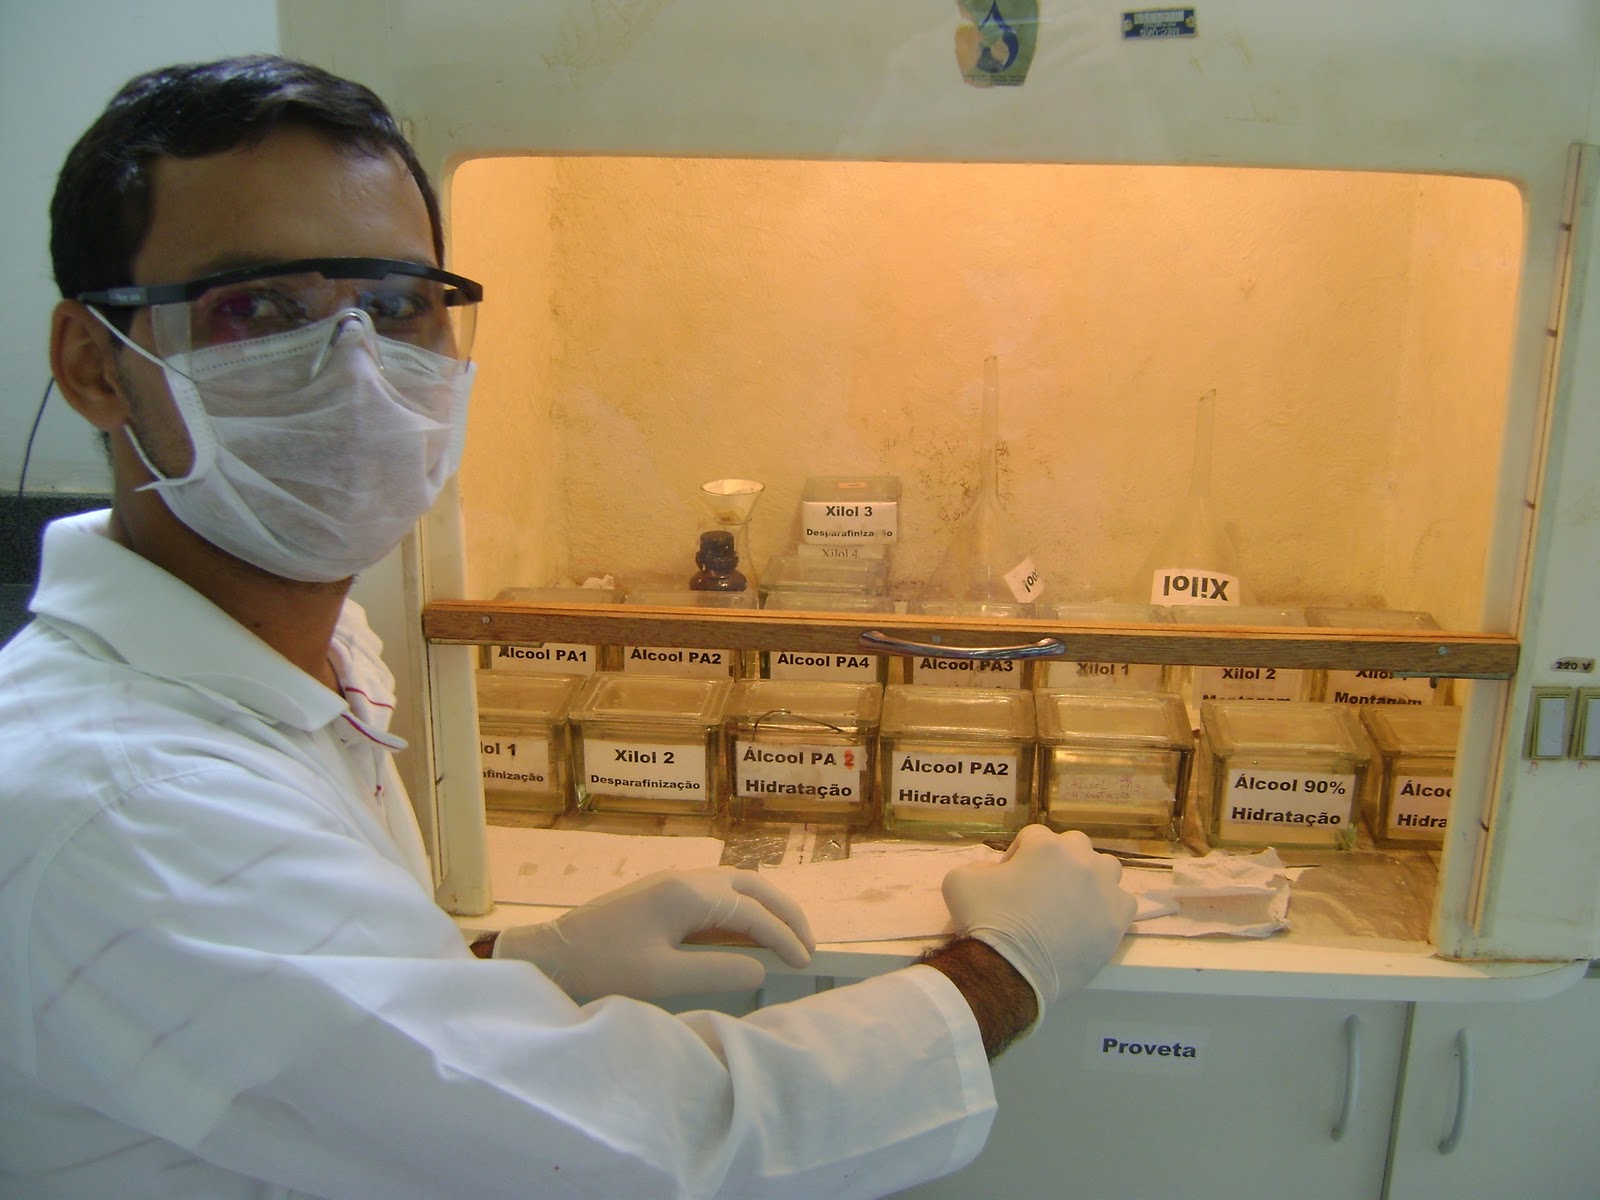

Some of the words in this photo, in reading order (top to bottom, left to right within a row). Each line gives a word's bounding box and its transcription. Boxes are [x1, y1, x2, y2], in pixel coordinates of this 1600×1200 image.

[826, 506, 859, 517] Xilol
[864, 506, 873, 517] 3
[806, 528, 893, 539] Desparafinizao
[822, 548, 848, 558] Xilol
[1163, 575, 1230, 602] Xilol
[556, 649, 587, 662] PA1
[631, 646, 683, 662] Álcool
[689, 652, 721, 665] PA2
[836, 657, 870, 668] PA4
[979, 660, 1014, 672] PA3
[1076, 662, 1115, 677] Xilol
[1121, 665, 1129, 676] 1
[1556, 661, 1578, 670] 220
[1582, 662, 1591, 671] V
[1222, 668, 1260, 679] Xilol
[1265, 668, 1276, 680] 2
[507, 743, 516, 756] 1
[615, 749, 657, 764] Xilol
[663, 752, 675, 764] 2
[743, 746, 804, 765] Álcool
[811, 752, 836, 766] PA
[900, 756, 963, 774] Álcool
[970, 762, 1009, 776] PA2
[591, 774, 701, 791] Desparafinização
[746, 779, 853, 800] Hidratação
[1234, 774, 1298, 792] Álcool
[1304, 780, 1346, 795] 90%
[899, 788, 1008, 809] Hidratação
[1232, 806, 1342, 827] Hidratação
[1103, 1038, 1196, 1058] Proveta
